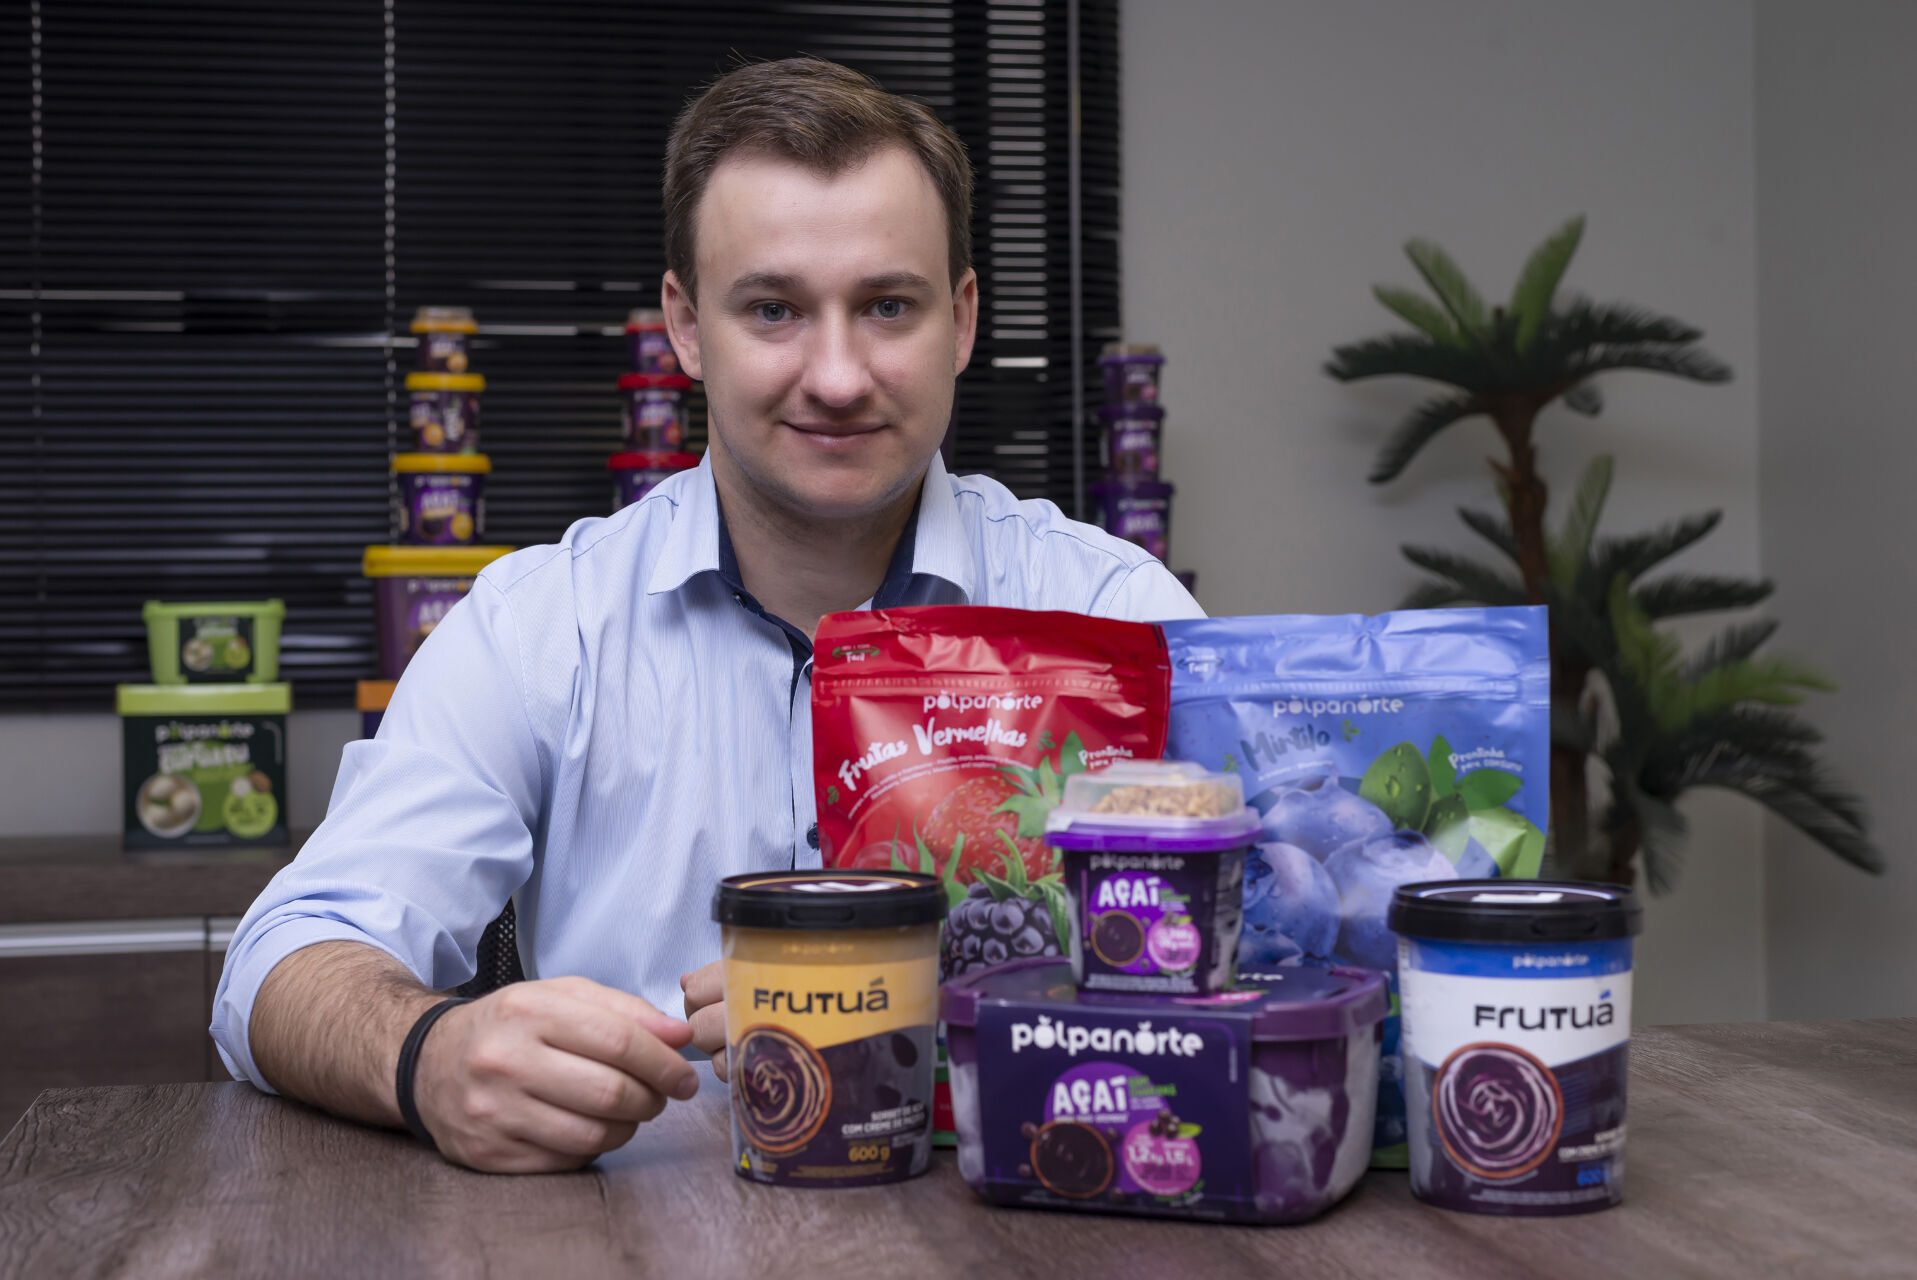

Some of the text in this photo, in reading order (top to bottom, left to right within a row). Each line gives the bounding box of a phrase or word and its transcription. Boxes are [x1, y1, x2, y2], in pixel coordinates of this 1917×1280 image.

[837, 739, 908, 791] Frutas
[912, 717, 1027, 756] Vermelhas
[1240, 724, 1331, 772] Mirtilo
[1097, 876, 1161, 908] AÇAÍ
[1010, 1014, 1205, 1058] polpanorte
[1052, 1075, 1128, 1116] AÇAÍ
[848, 1145, 879, 1162] 600
